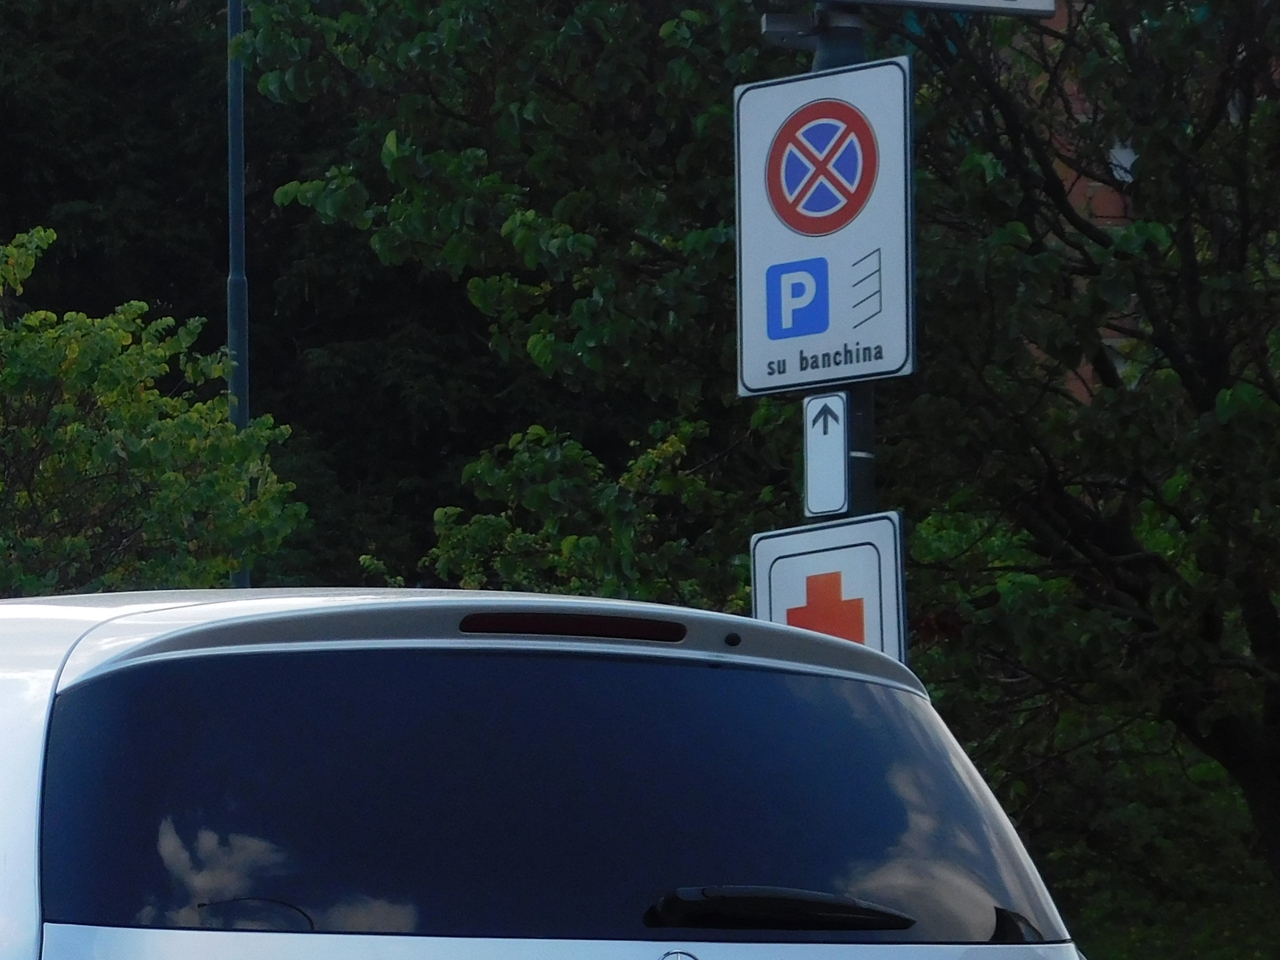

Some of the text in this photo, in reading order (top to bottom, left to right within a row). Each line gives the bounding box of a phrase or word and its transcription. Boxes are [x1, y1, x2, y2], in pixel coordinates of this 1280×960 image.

[781, 271, 816, 329] P
[767, 342, 884, 375] su banchina
